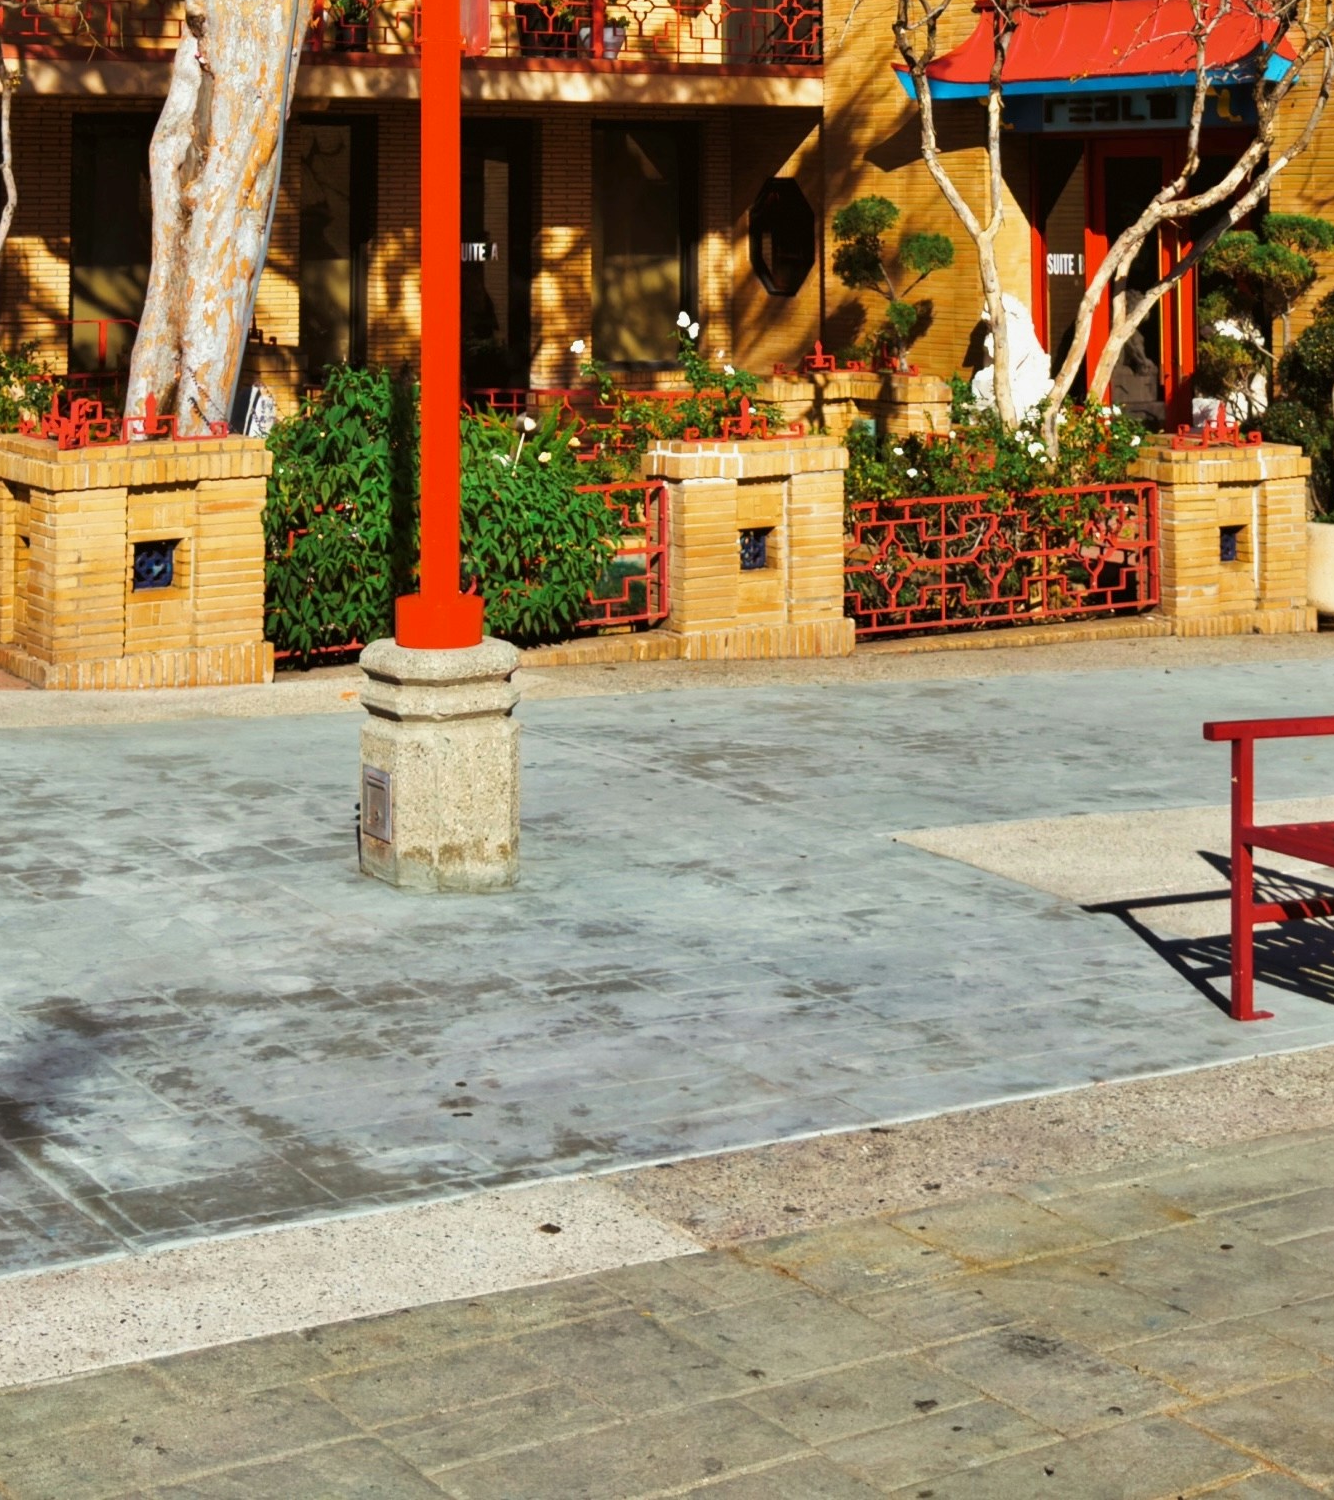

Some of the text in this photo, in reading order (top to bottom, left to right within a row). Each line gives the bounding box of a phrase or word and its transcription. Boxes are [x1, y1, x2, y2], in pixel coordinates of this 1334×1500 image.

[461, 242, 499, 262] UITE A
[1047, 253, 1075, 275] SUITE
